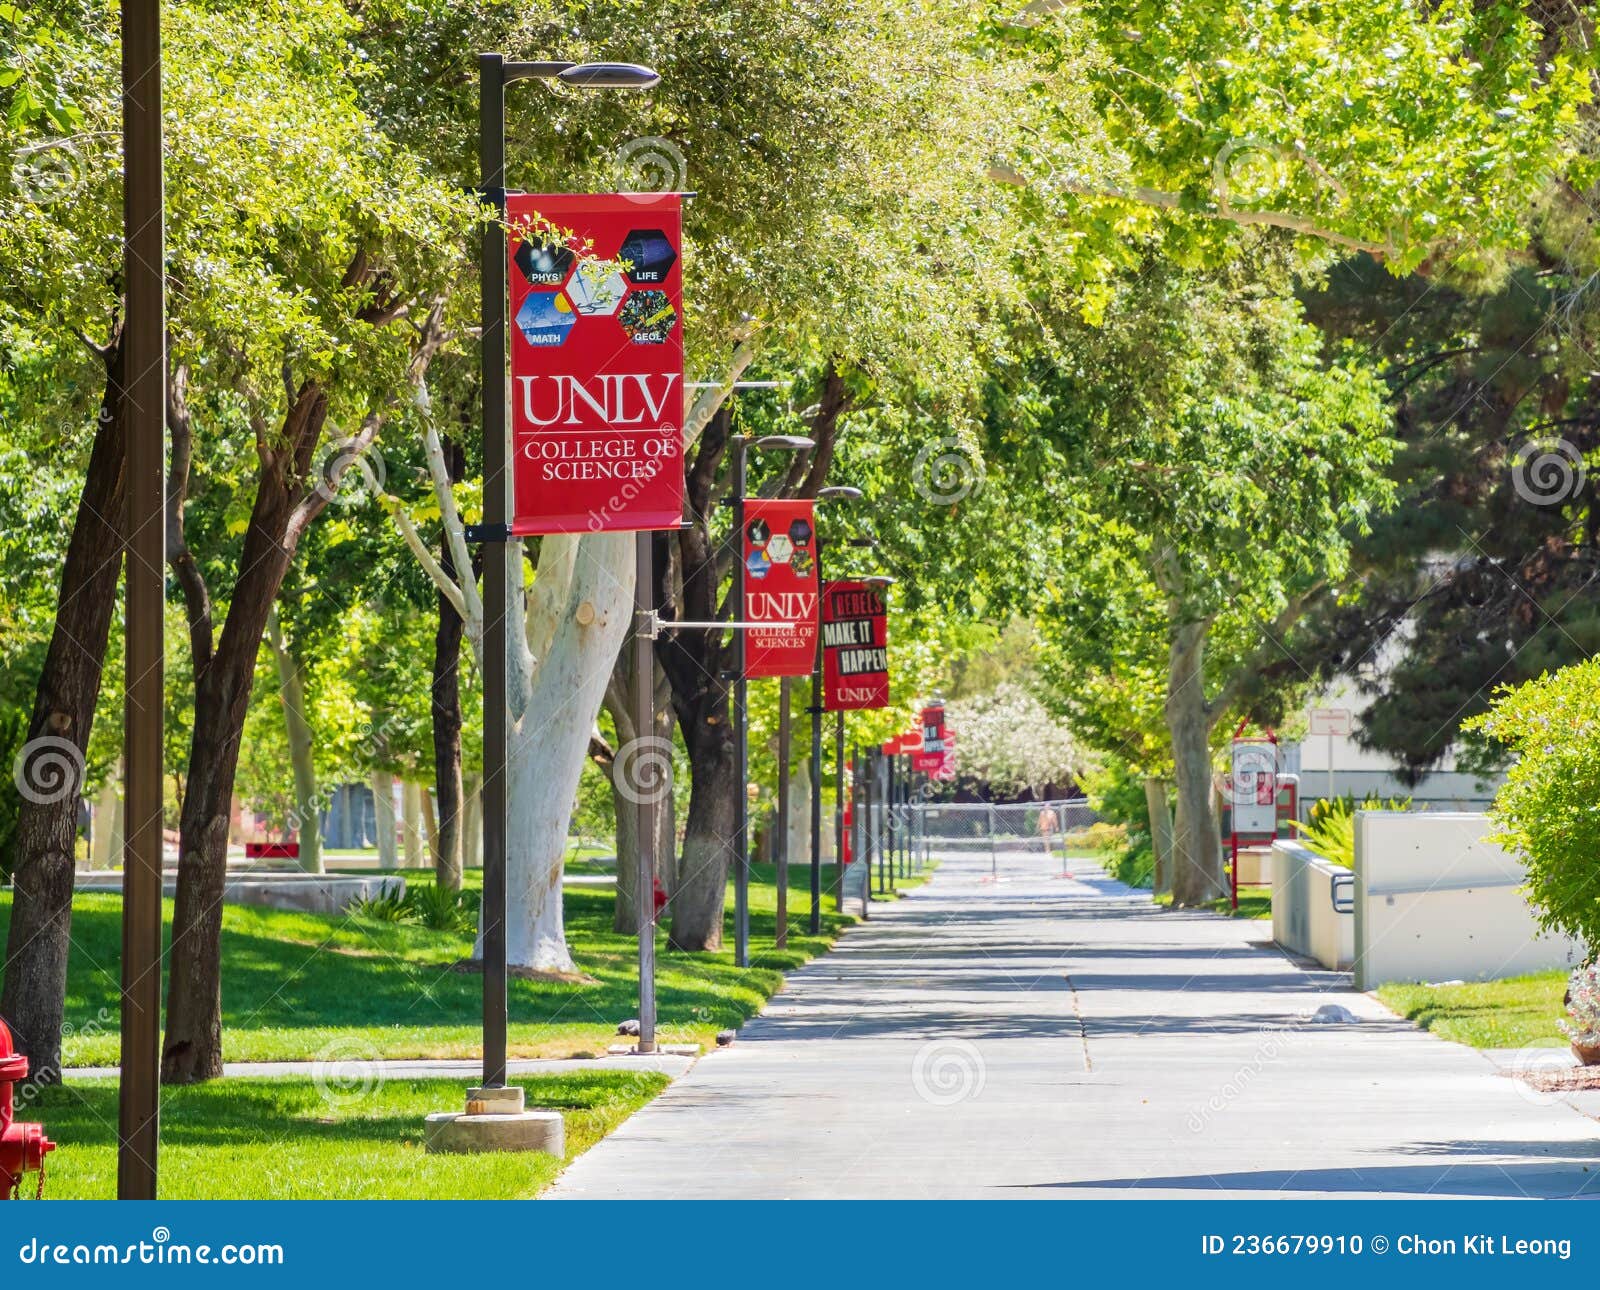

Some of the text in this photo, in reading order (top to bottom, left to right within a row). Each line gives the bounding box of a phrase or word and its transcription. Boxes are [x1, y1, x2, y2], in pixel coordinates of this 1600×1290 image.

[636, 271, 658, 280] LIFE
[532, 334, 561, 343] MATH
[634, 332, 662, 341] GEOL
[515, 373, 680, 425] UNLV
[524, 438, 674, 461] COLLEGE OF
[542, 460, 657, 481] SCIENCES
[746, 592, 817, 620] UNLV
[748, 626, 815, 638] COLLEGE OF
[824, 621, 871, 646] MAKE IT
[755, 637, 806, 649] SCIENCES
[841, 648, 887, 673] HAPPEN
[837, 687, 878, 702] UNLV
